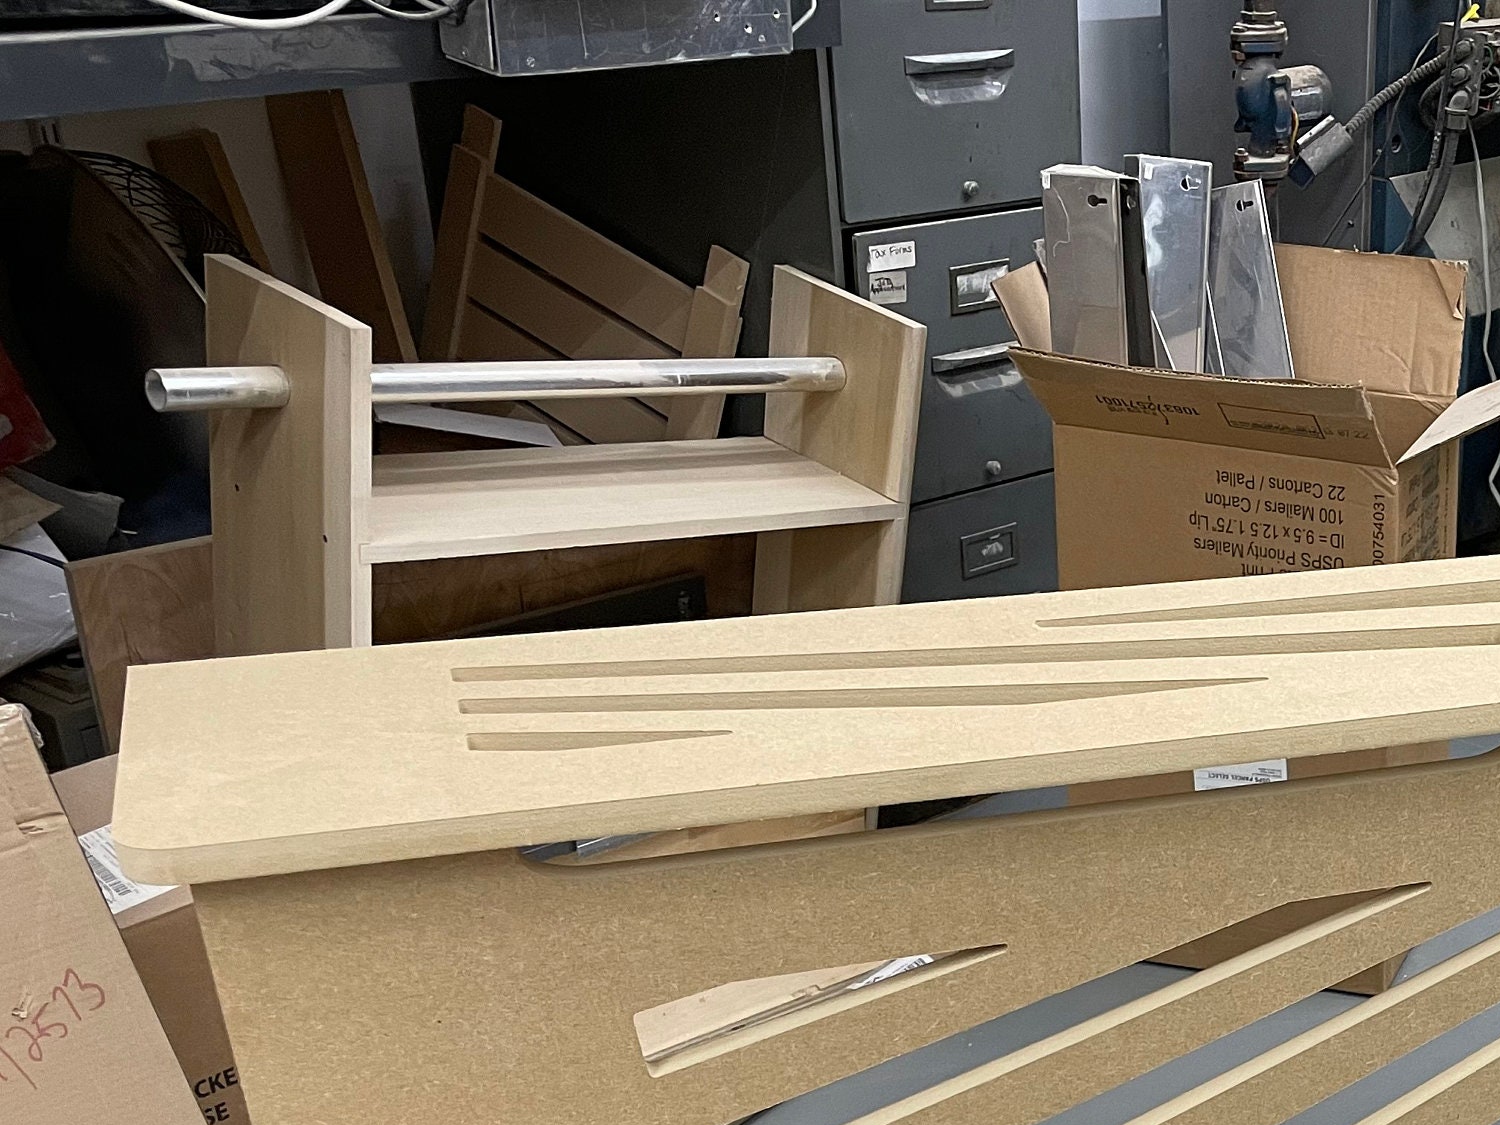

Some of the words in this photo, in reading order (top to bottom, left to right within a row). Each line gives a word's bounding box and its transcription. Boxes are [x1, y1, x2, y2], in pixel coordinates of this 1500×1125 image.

[870, 248, 887, 259] Tax
[889, 246, 912, 256] Forms
[1216, 470, 1255, 490] Pallet
[1260, 476, 1264, 491] /
[1269, 477, 1323, 499] Cartons
[1328, 485, 1345, 501] 22
[1205, 492, 1251, 513] Carton
[1255, 500, 1260, 514] /
[1264, 500, 1314, 522] Mailers
[1189, 510, 1209, 531] Lip
[1320, 508, 1343, 525] 100
[1250, 522, 1279, 540] 12.5
[1283, 526, 1290, 538] x
[1294, 528, 1315, 544] 9.5
[1193, 537, 1244, 560] Mailers
[1330, 534, 1344, 549] ID
[1247, 541, 1296, 566] Priority
[1301, 552, 1344, 570] USPS
